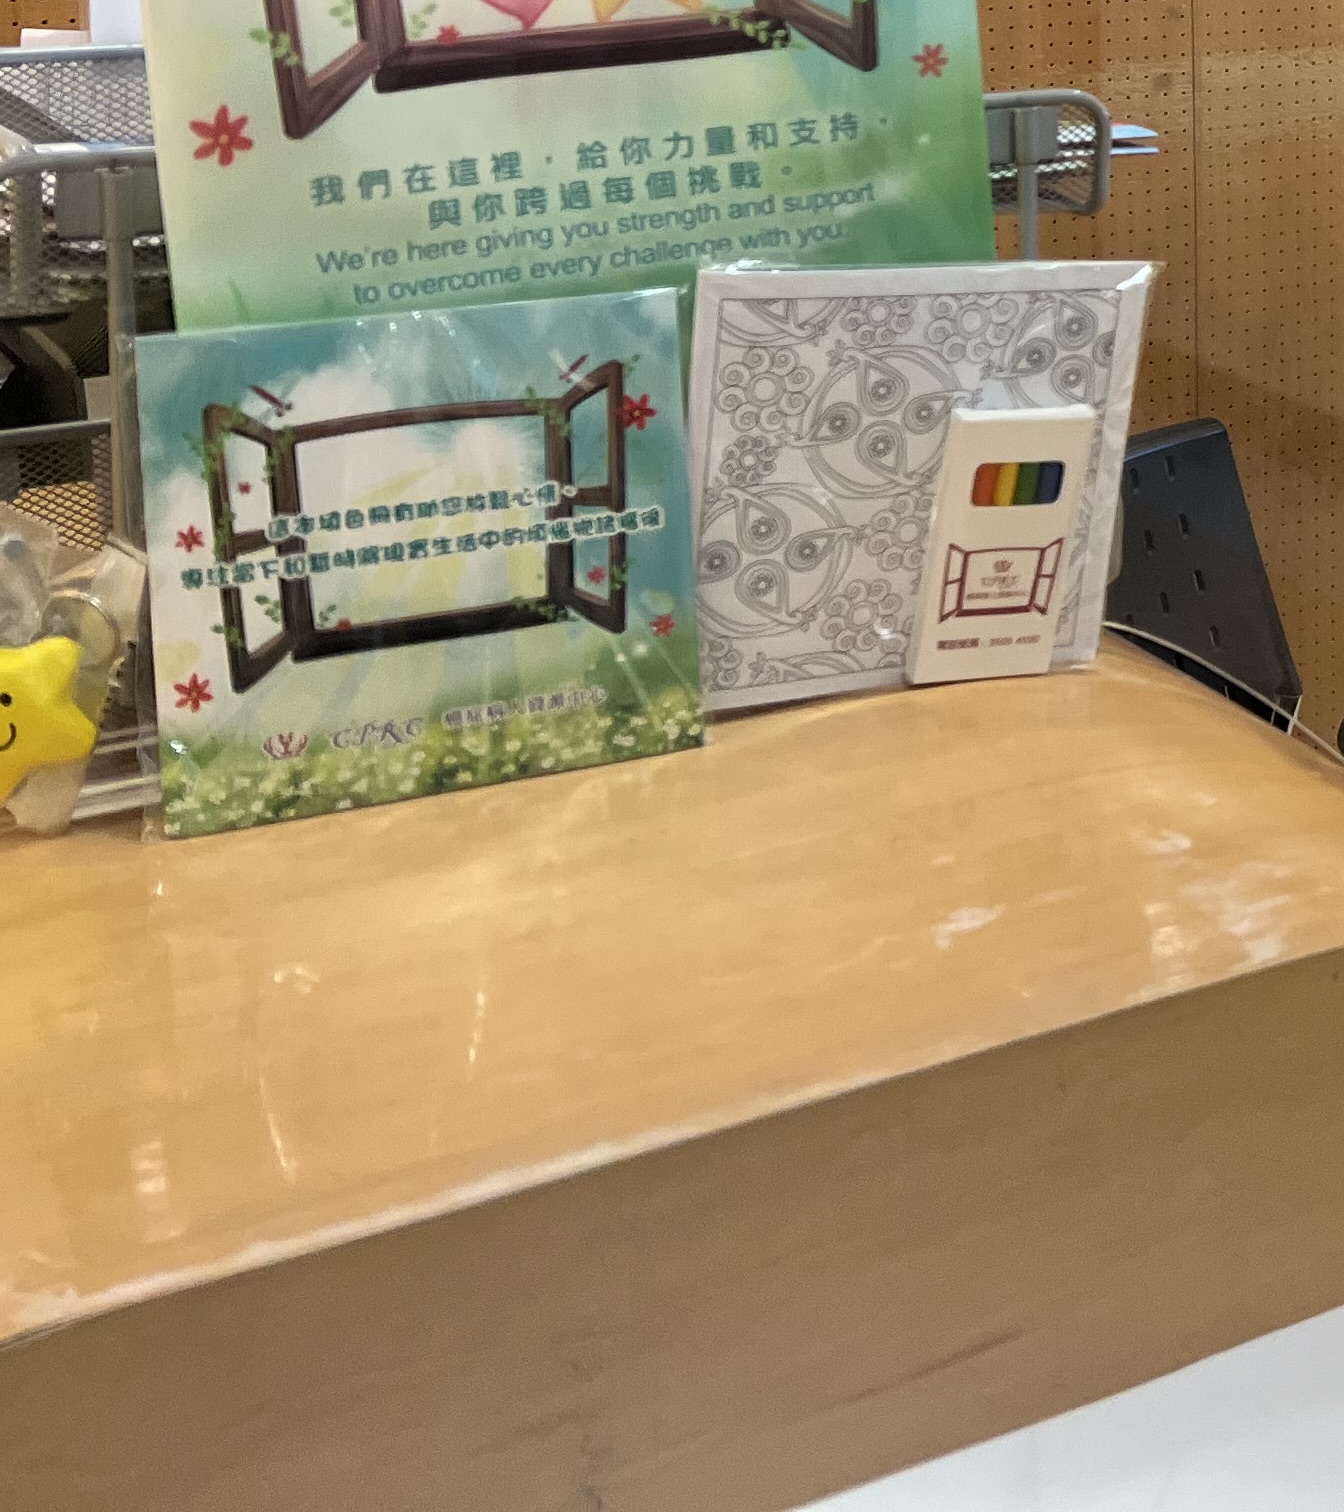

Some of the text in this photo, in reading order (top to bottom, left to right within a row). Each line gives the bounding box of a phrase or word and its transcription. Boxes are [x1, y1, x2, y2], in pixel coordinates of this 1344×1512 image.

[314, 182, 875, 274] We're here giving you strength and support
[353, 284, 381, 305] to
[387, 264, 522, 298] overcome
[529, 254, 603, 277] every
[609, 234, 732, 269] challenge
[738, 227, 792, 251] with
